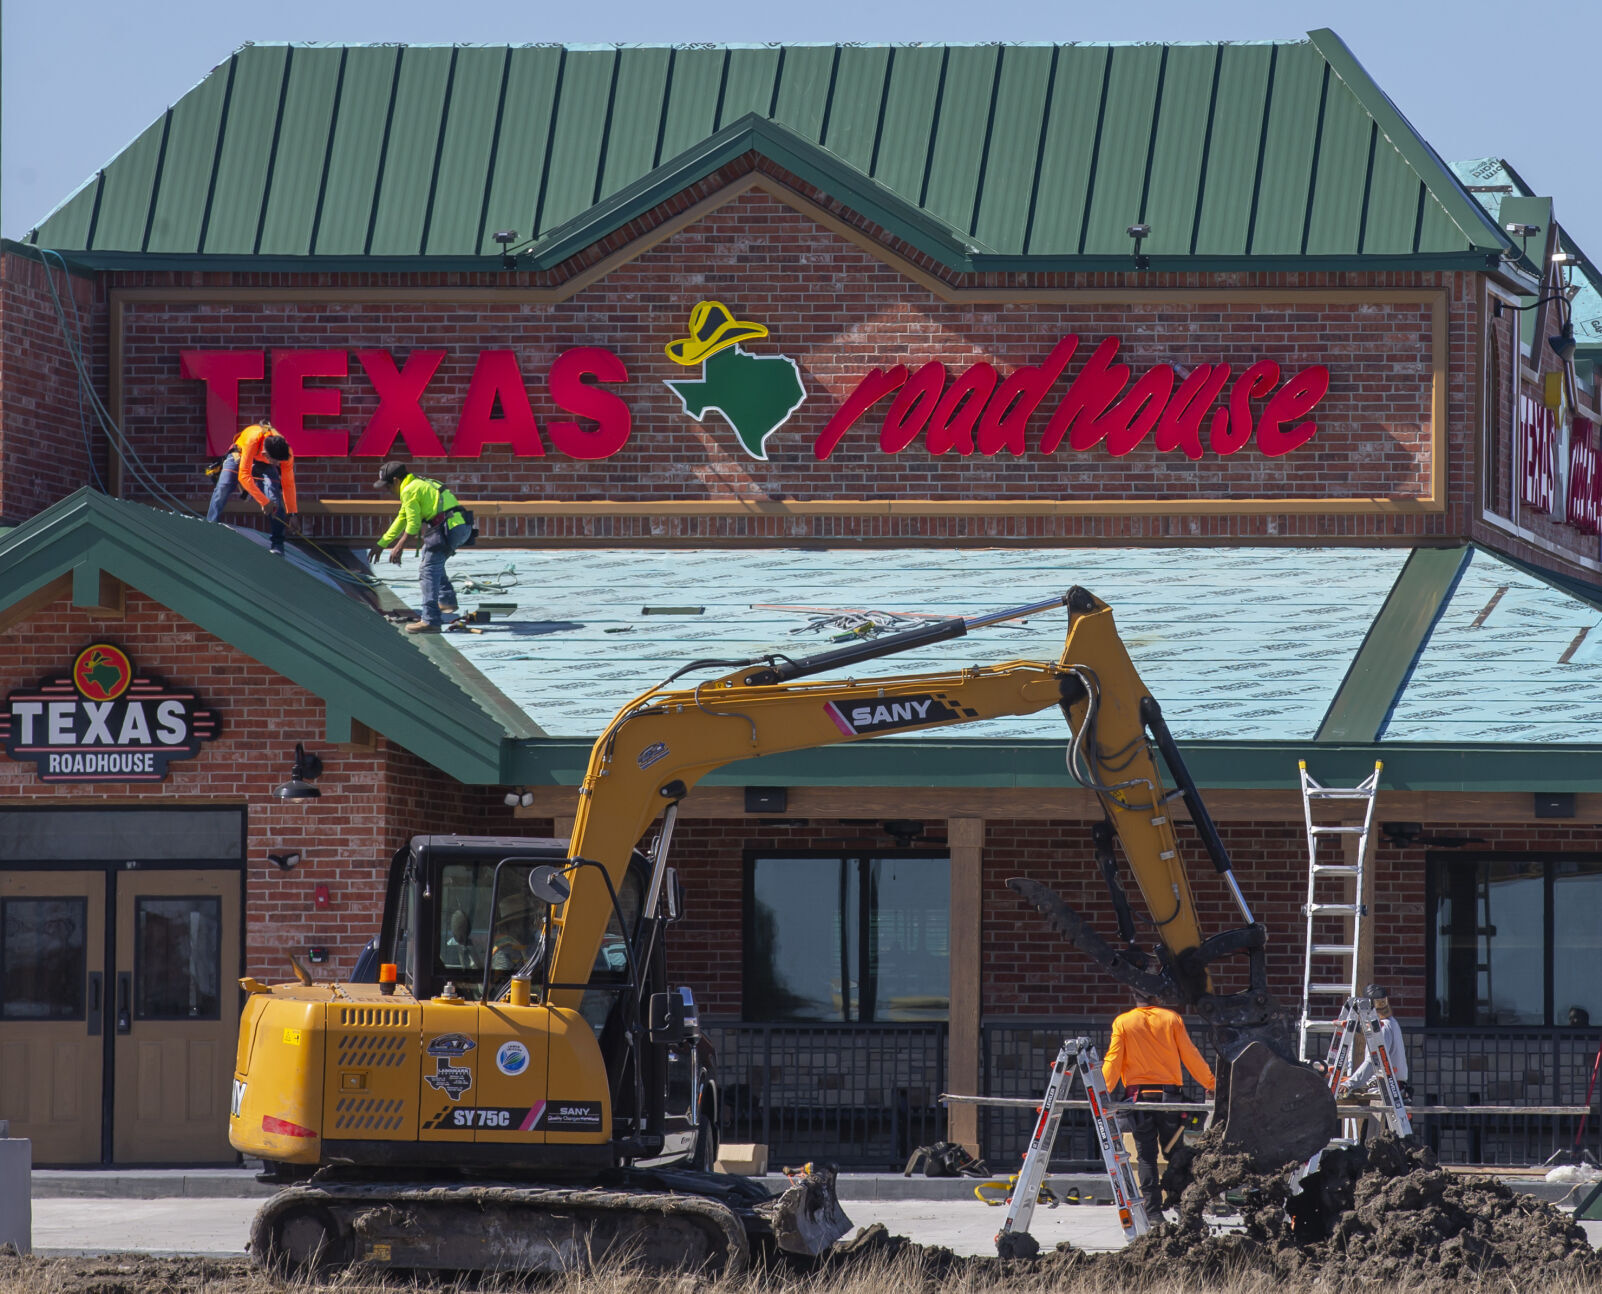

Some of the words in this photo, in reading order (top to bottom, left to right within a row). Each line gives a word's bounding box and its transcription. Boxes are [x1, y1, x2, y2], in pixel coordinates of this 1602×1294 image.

[180, 346, 631, 459] TEXAS
[814, 333, 1329, 460] roadhouse
[1519, 394, 1556, 515] TEXAS
[12, 700, 187, 745] TEXAS
[852, 699, 933, 726] SANY
[49, 753, 154, 773] ROADHOUSE
[454, 1110, 510, 1126] SY75C
[560, 1107, 590, 1116] SANY
